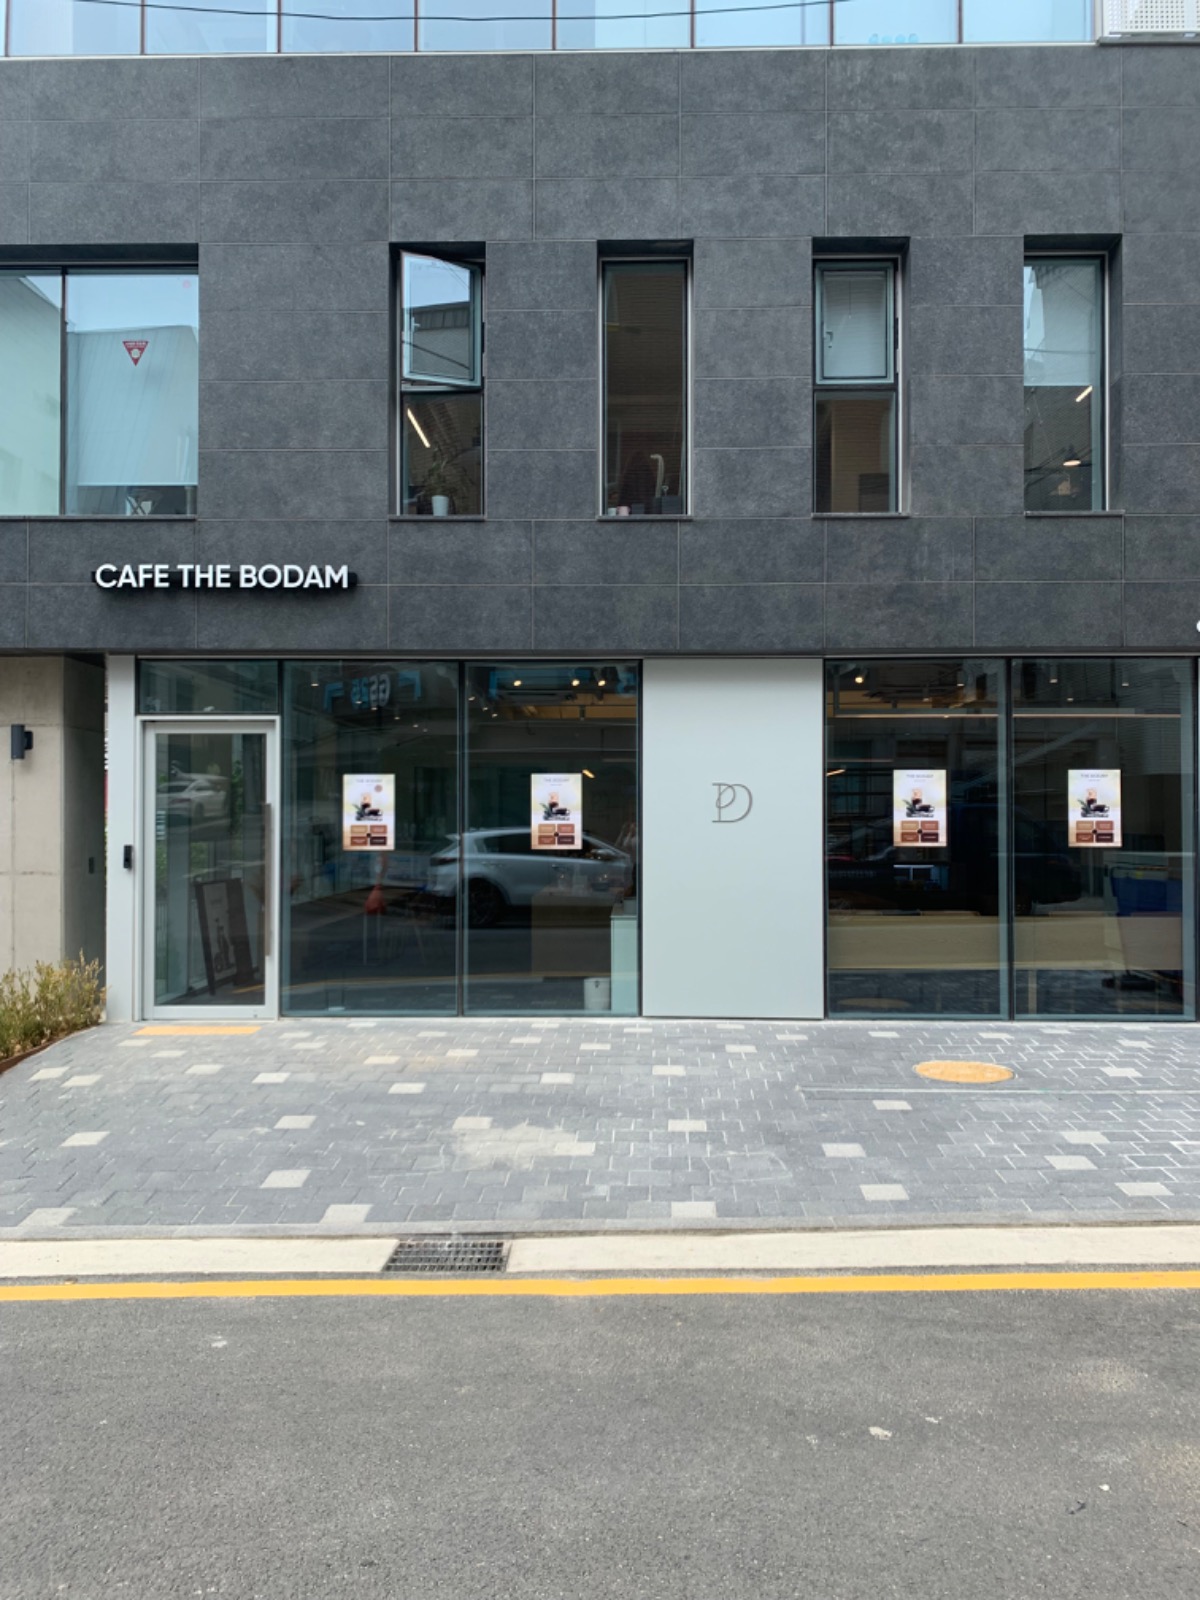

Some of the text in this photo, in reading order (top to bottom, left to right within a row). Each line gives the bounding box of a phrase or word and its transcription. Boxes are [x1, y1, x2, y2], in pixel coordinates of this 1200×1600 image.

[95, 564, 349, 588] CAFE THE BODAM
